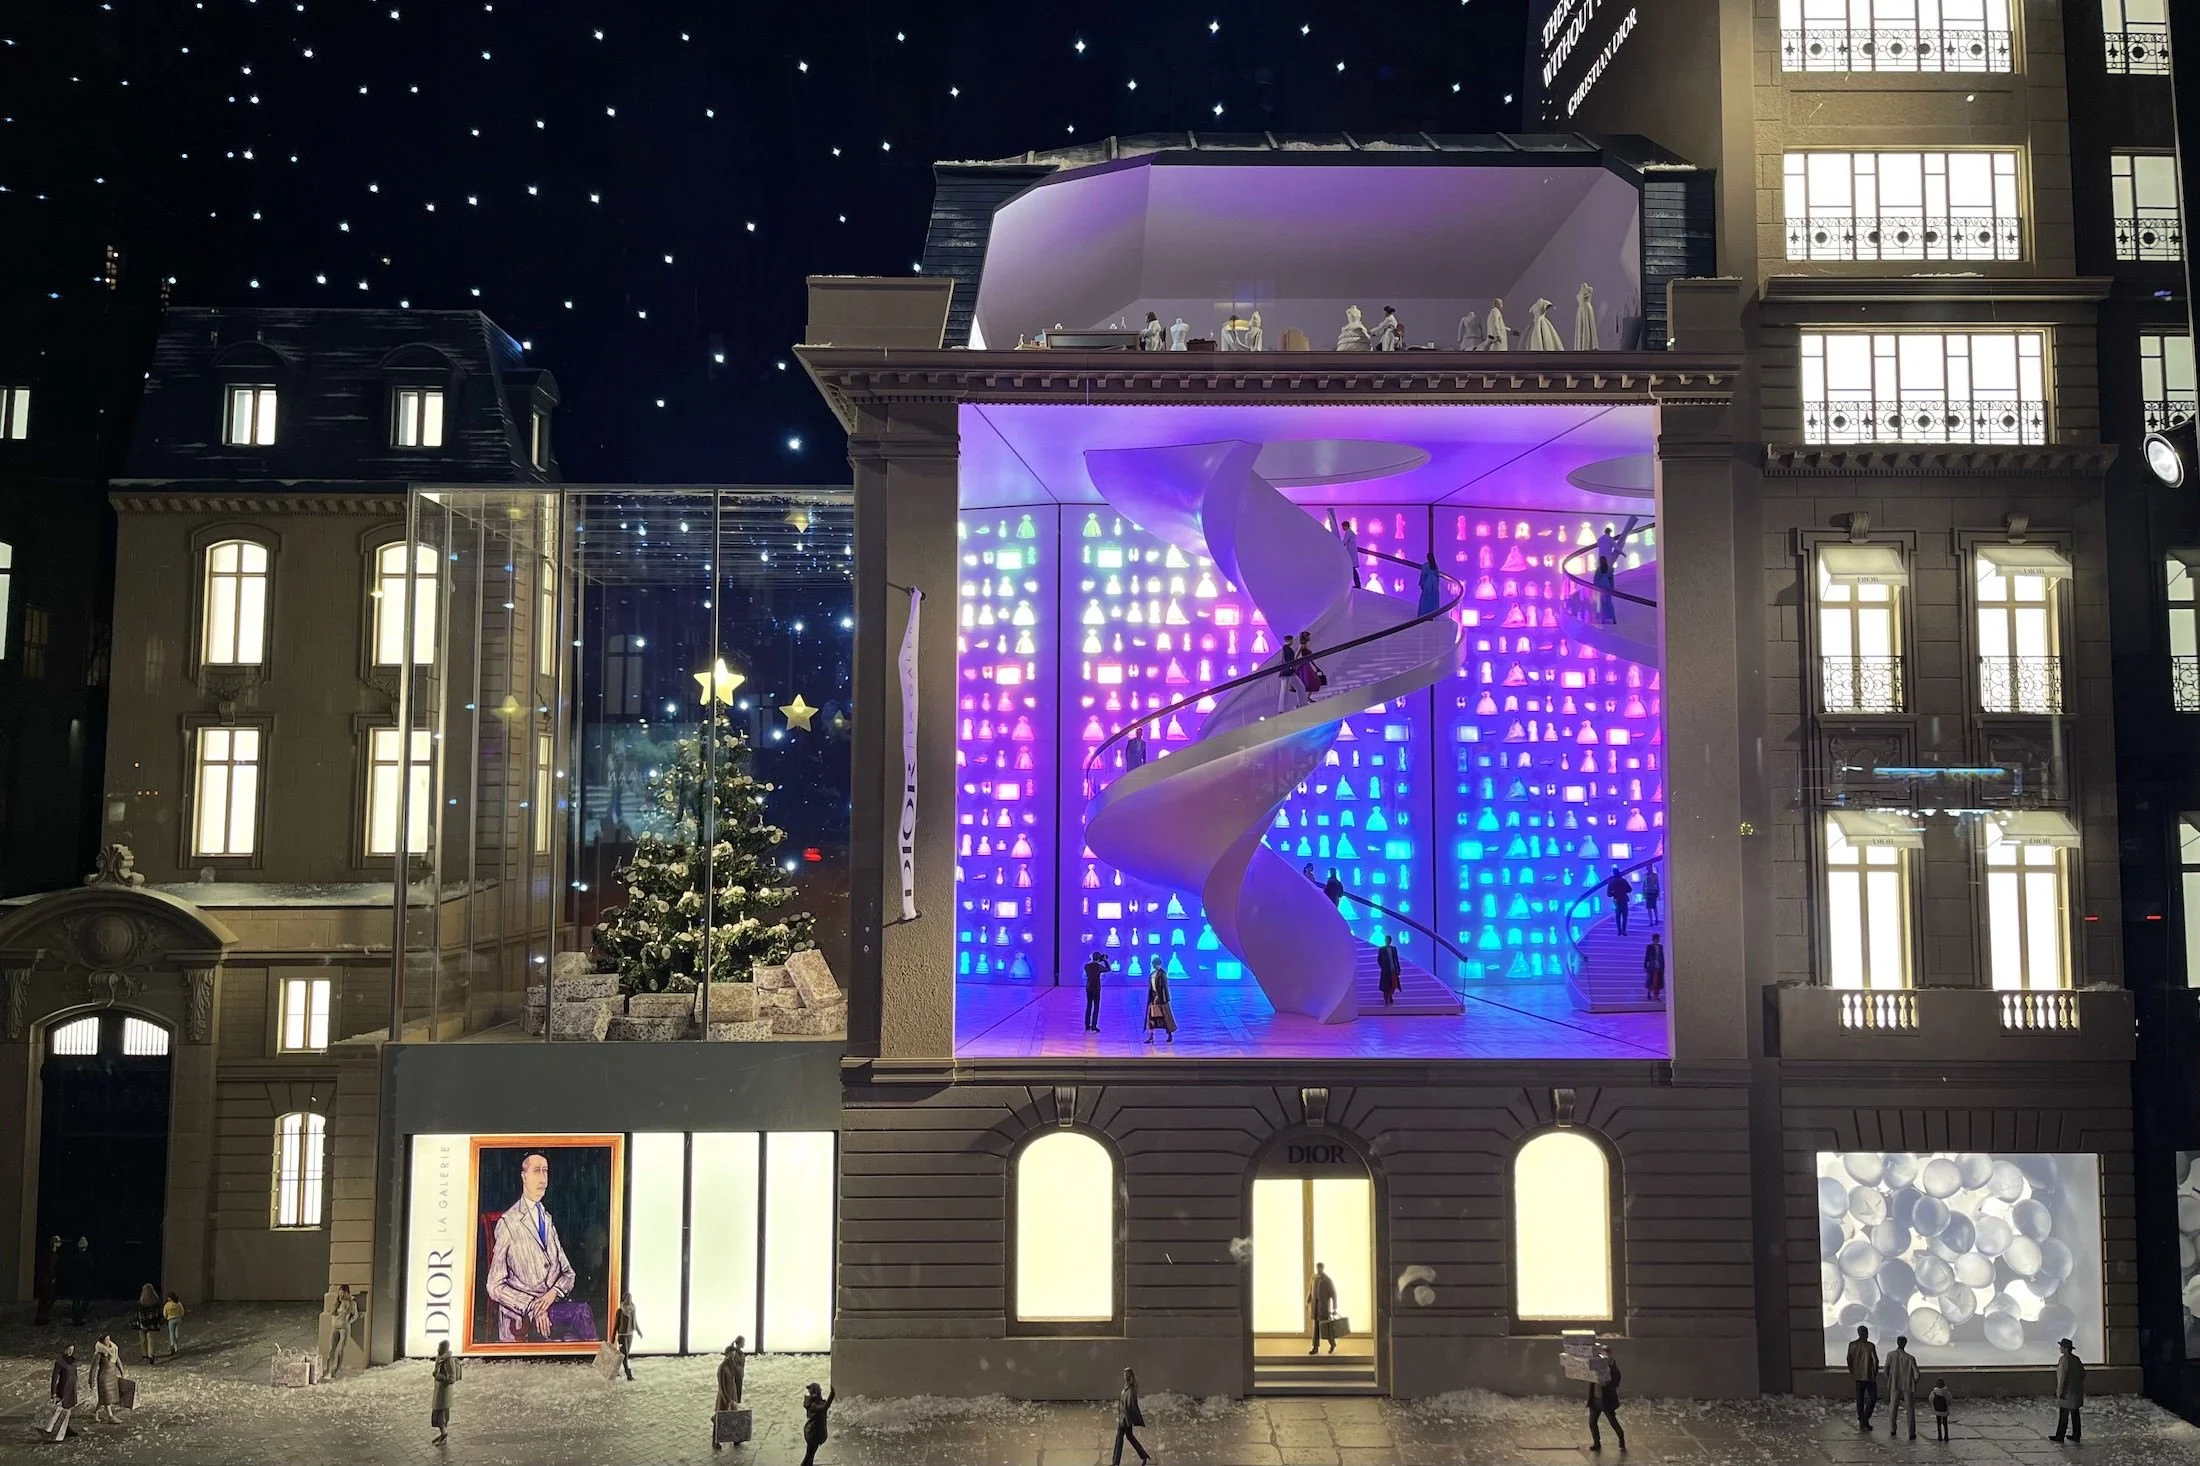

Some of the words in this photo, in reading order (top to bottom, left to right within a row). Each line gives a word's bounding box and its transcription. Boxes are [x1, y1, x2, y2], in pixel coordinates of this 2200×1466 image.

[1543, 0, 1576, 49] THER
[1543, 0, 1595, 88] WITHOUT
[1568, 41, 1612, 116] CHRISTIAN
[1613, 7, 1638, 53] DIOR
[1872, 837, 1895, 845] DIOR
[2029, 837, 2051, 845] DIOR
[438, 1146, 450, 1209] GALERIE
[1287, 1145, 1346, 1164] DIOR
[437, 1216, 447, 1233] LA
[425, 1246, 454, 1337] DIOR
